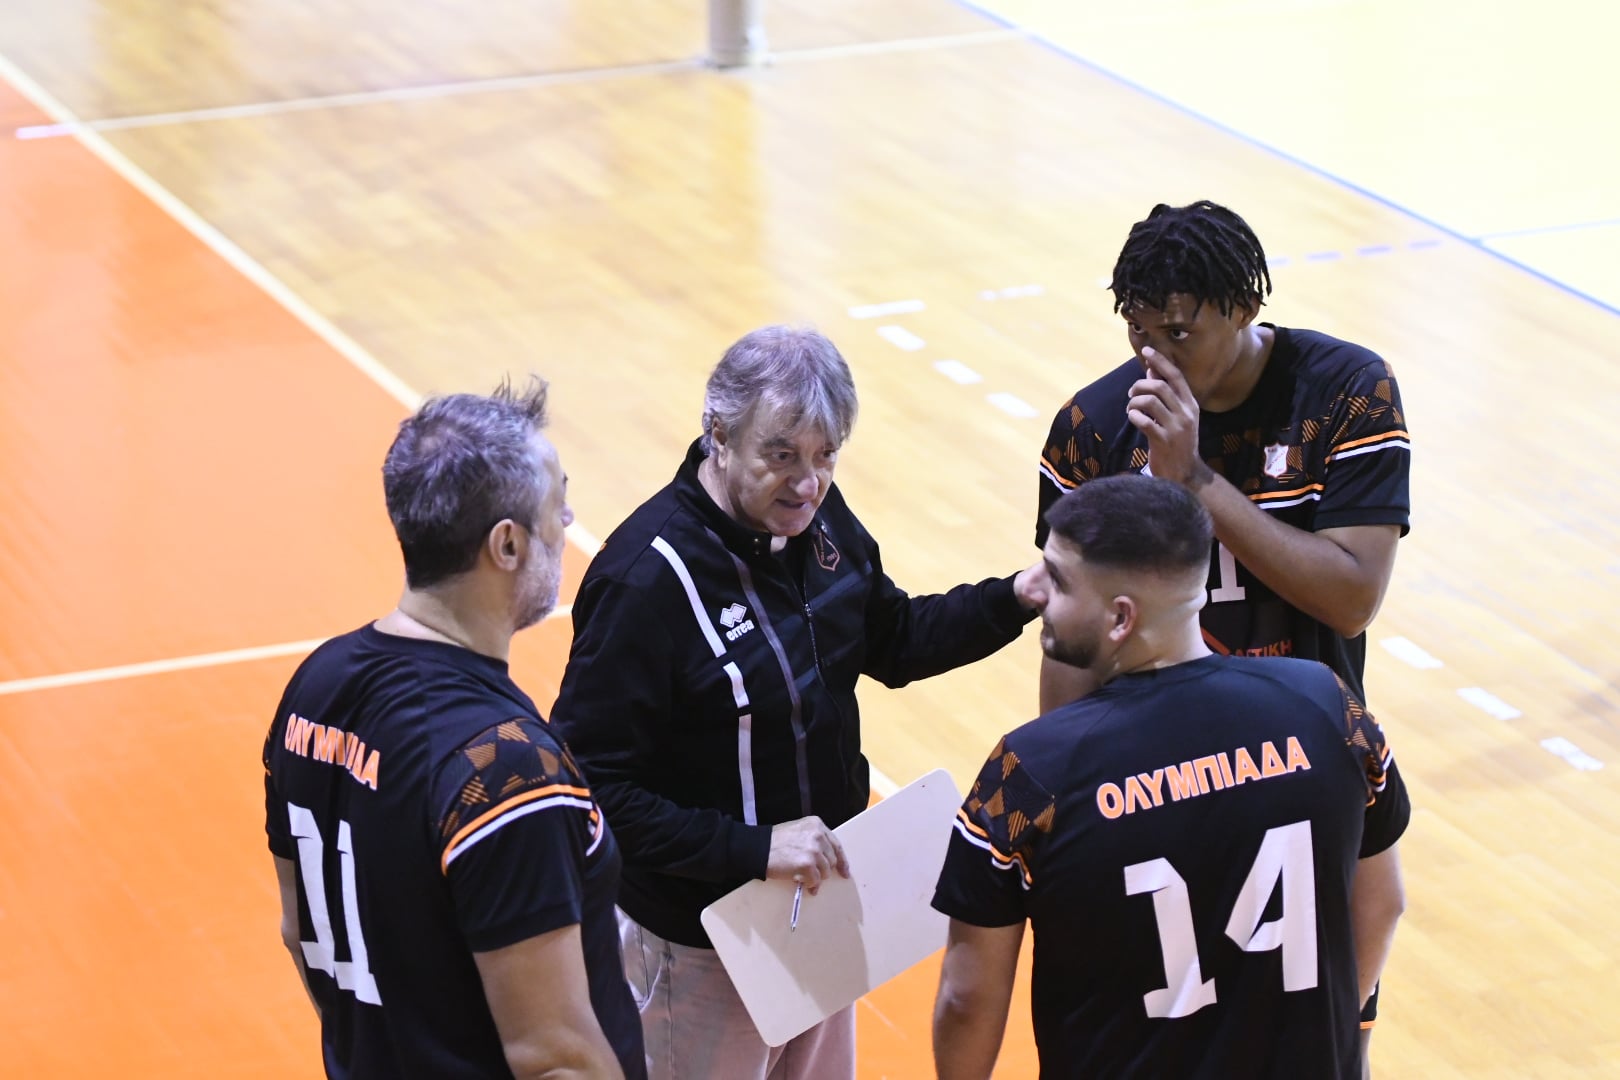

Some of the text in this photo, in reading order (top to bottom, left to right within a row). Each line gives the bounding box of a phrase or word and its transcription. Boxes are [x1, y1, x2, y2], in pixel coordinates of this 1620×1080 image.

[1096, 736, 1312, 819] ΟΛΥΜΠΙΑΔΑ
[287, 801, 383, 1006] 11
[1123, 819, 1319, 1019] 14
